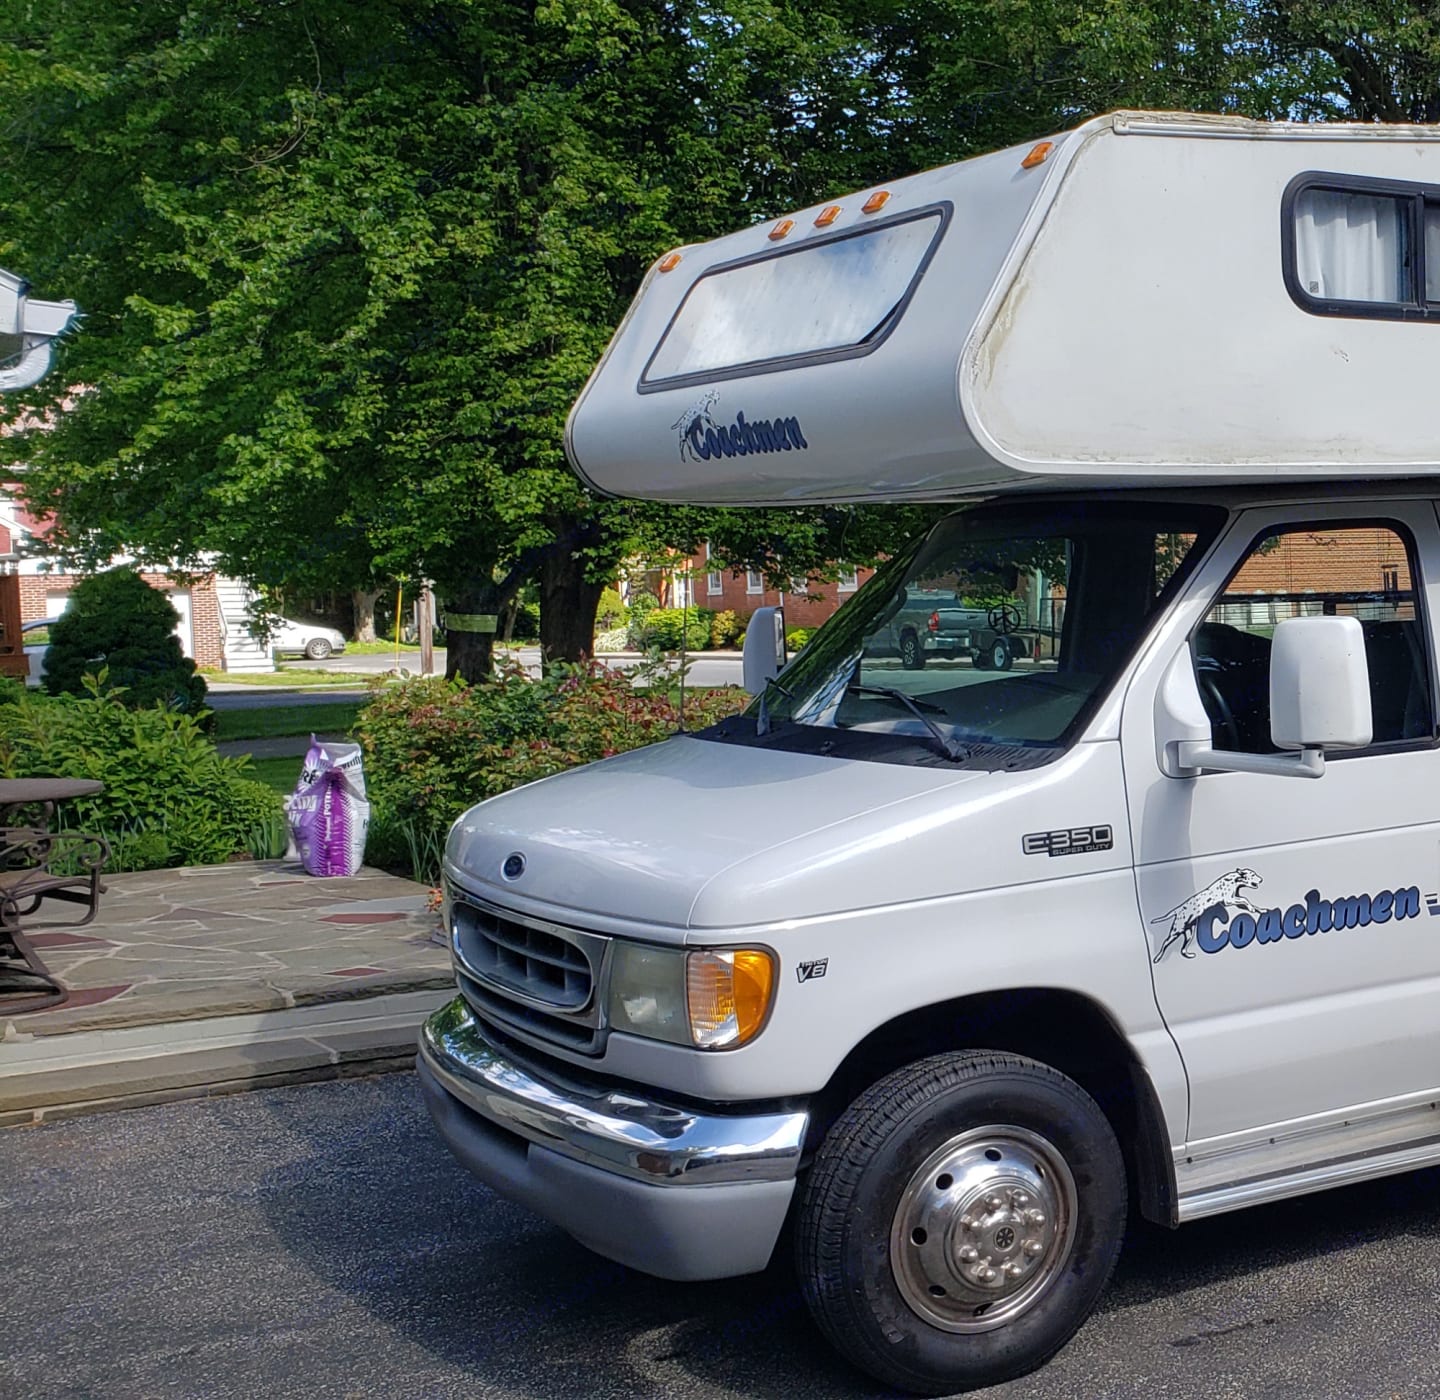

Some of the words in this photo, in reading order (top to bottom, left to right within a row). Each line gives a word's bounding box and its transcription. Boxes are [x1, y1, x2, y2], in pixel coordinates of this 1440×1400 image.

[689, 410, 808, 461] Coachmen
[1052, 845, 1084, 856] SUPER
[1085, 842, 1110, 852] DUTY
[1196, 886, 1421, 954] Coachmen
[797, 964, 826, 983] V8
